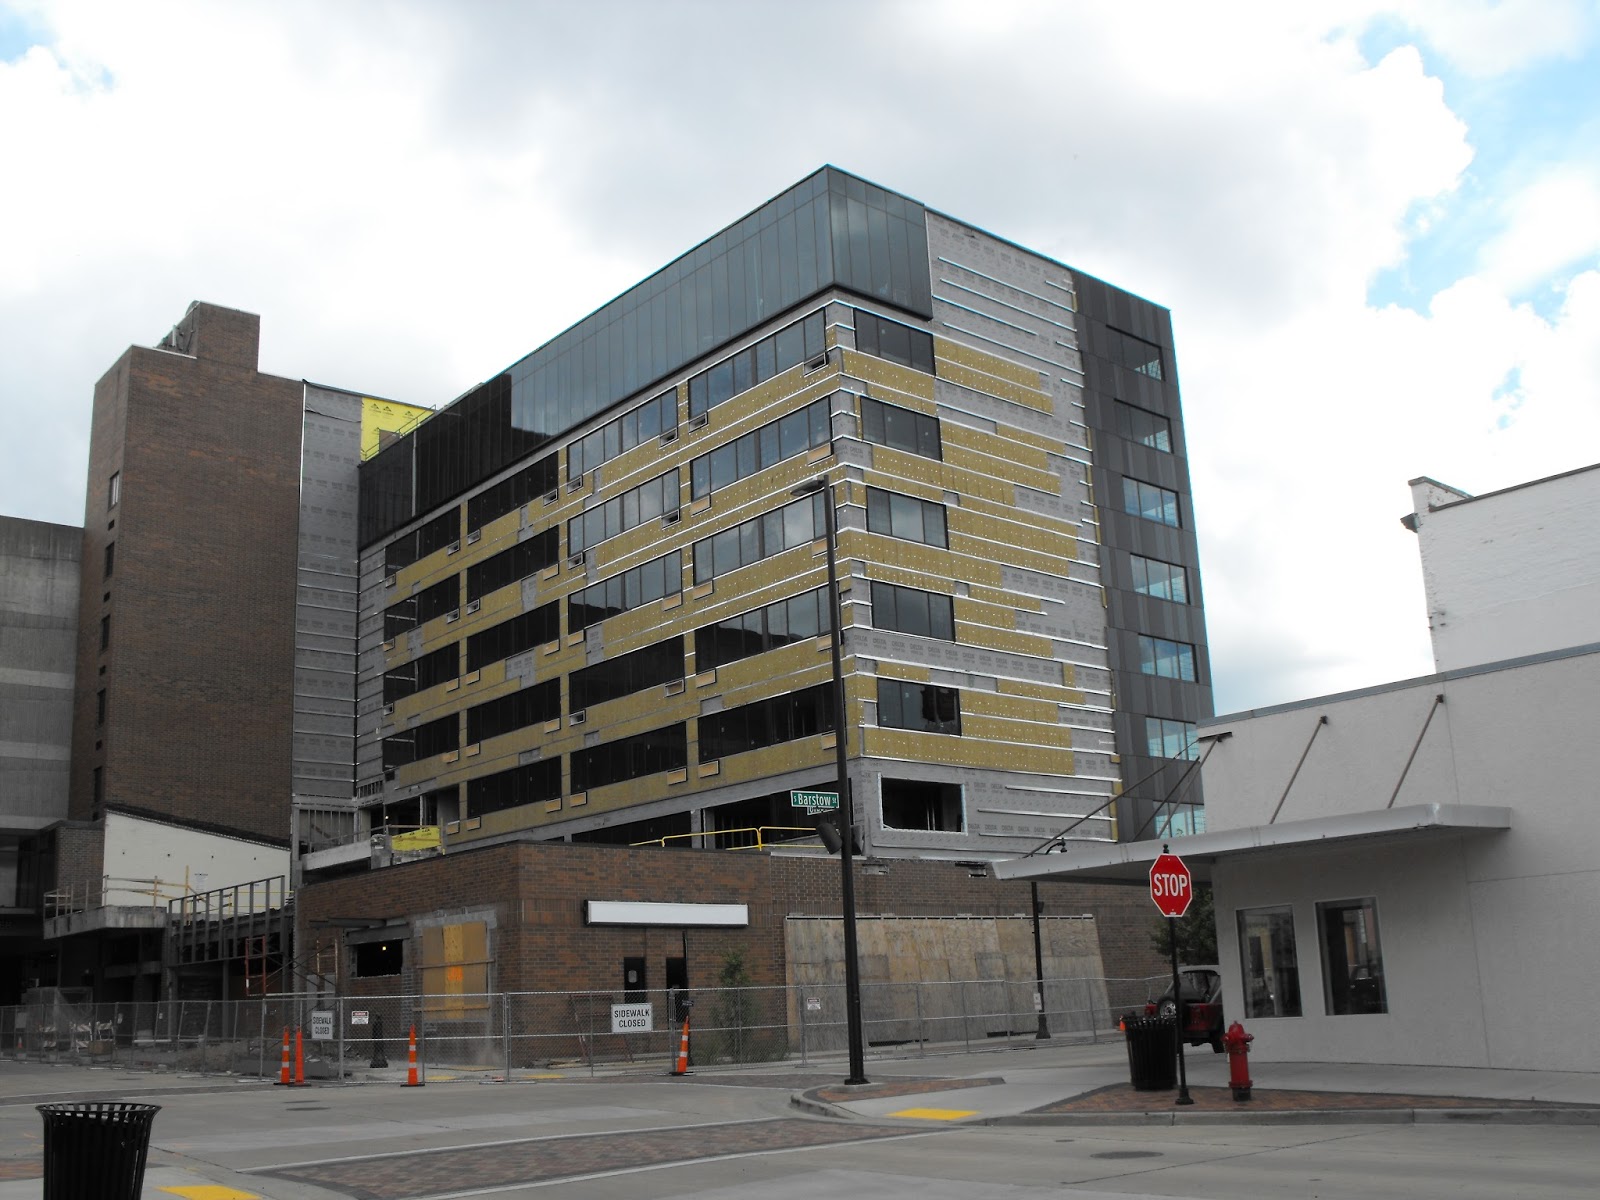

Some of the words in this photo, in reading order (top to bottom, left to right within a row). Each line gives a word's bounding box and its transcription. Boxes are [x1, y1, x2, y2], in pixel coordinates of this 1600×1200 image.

[797, 793, 831, 805] Barstow
[1153, 873, 1188, 896] STOP
[614, 1009, 650, 1018] SIDEWALK
[618, 1018, 646, 1028] CLOSED
